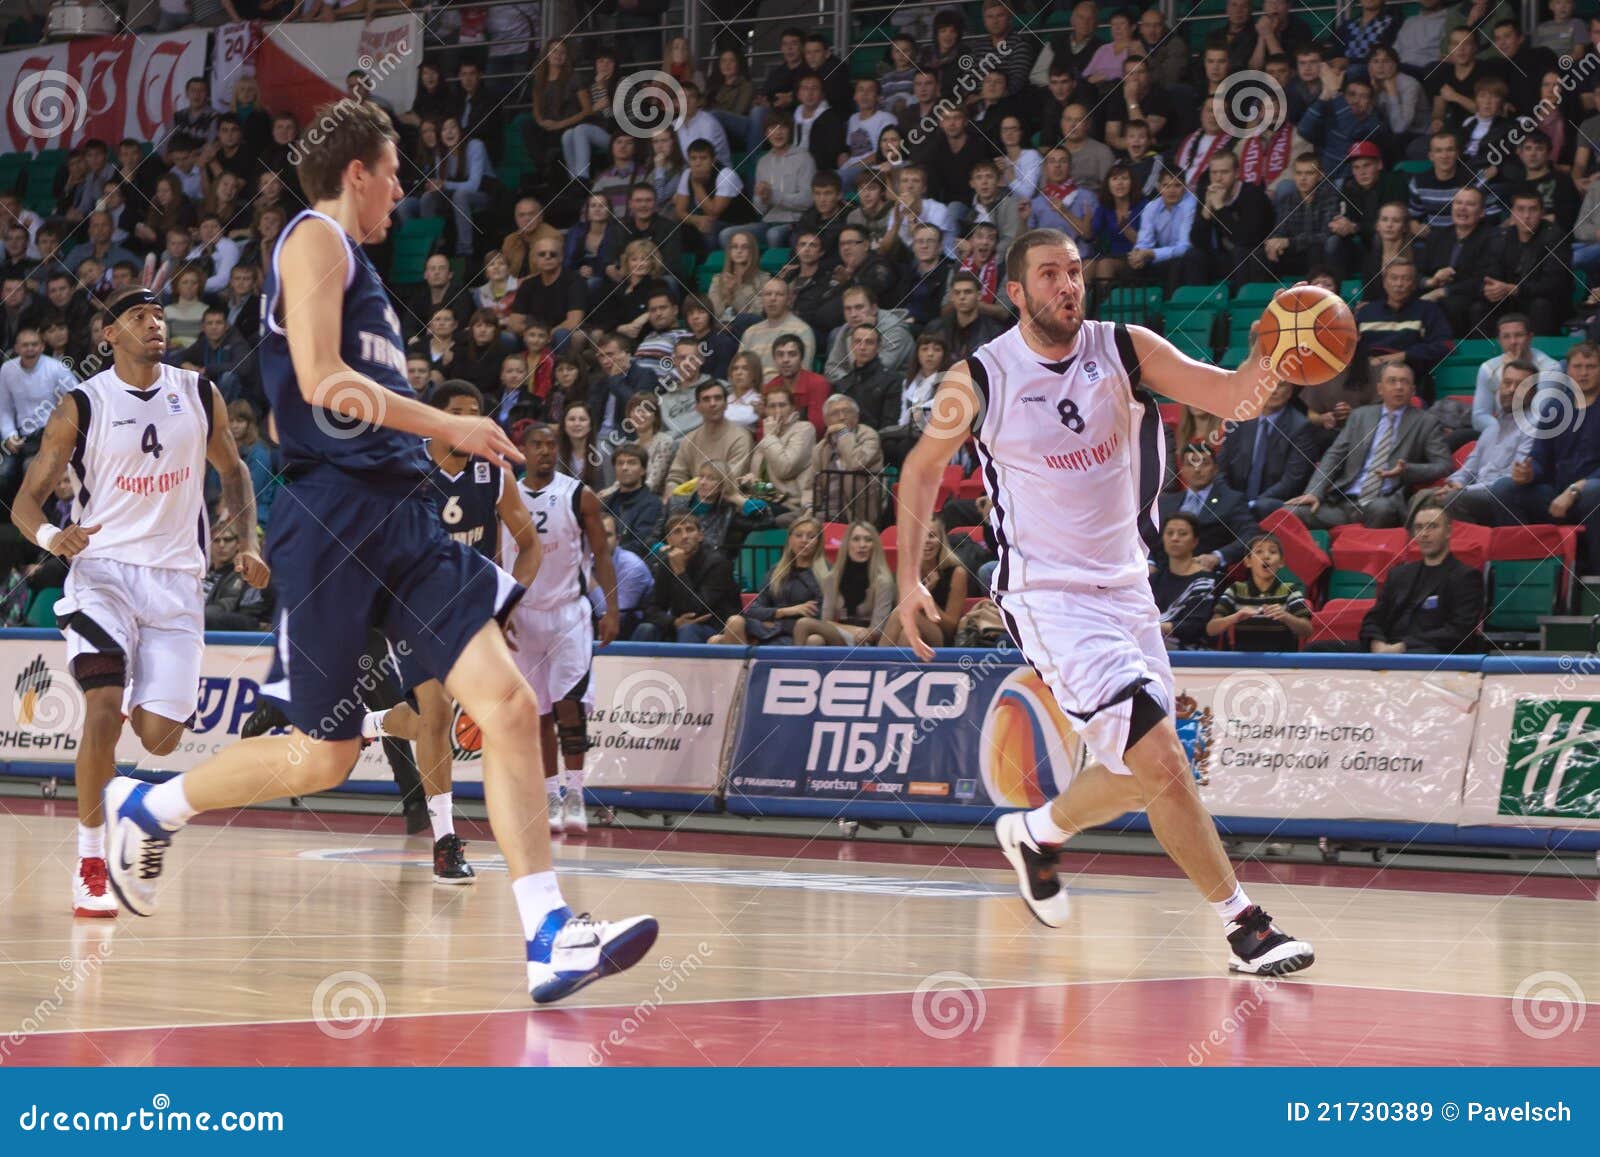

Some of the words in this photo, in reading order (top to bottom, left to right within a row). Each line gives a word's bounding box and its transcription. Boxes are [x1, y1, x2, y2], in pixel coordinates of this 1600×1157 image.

[1057, 399, 1086, 435] 8
[141, 424, 163, 459] 4
[442, 496, 463, 524] 6
[530, 511, 548, 533] 2
[762, 668, 970, 719] BEKO
[609, 705, 714, 726] баскетбола
[604, 731, 681, 751] области
[1225, 719, 1375, 743] Правительство
[806, 721, 915, 774] ПБЛ
[1220, 748, 1329, 772] Самарской
